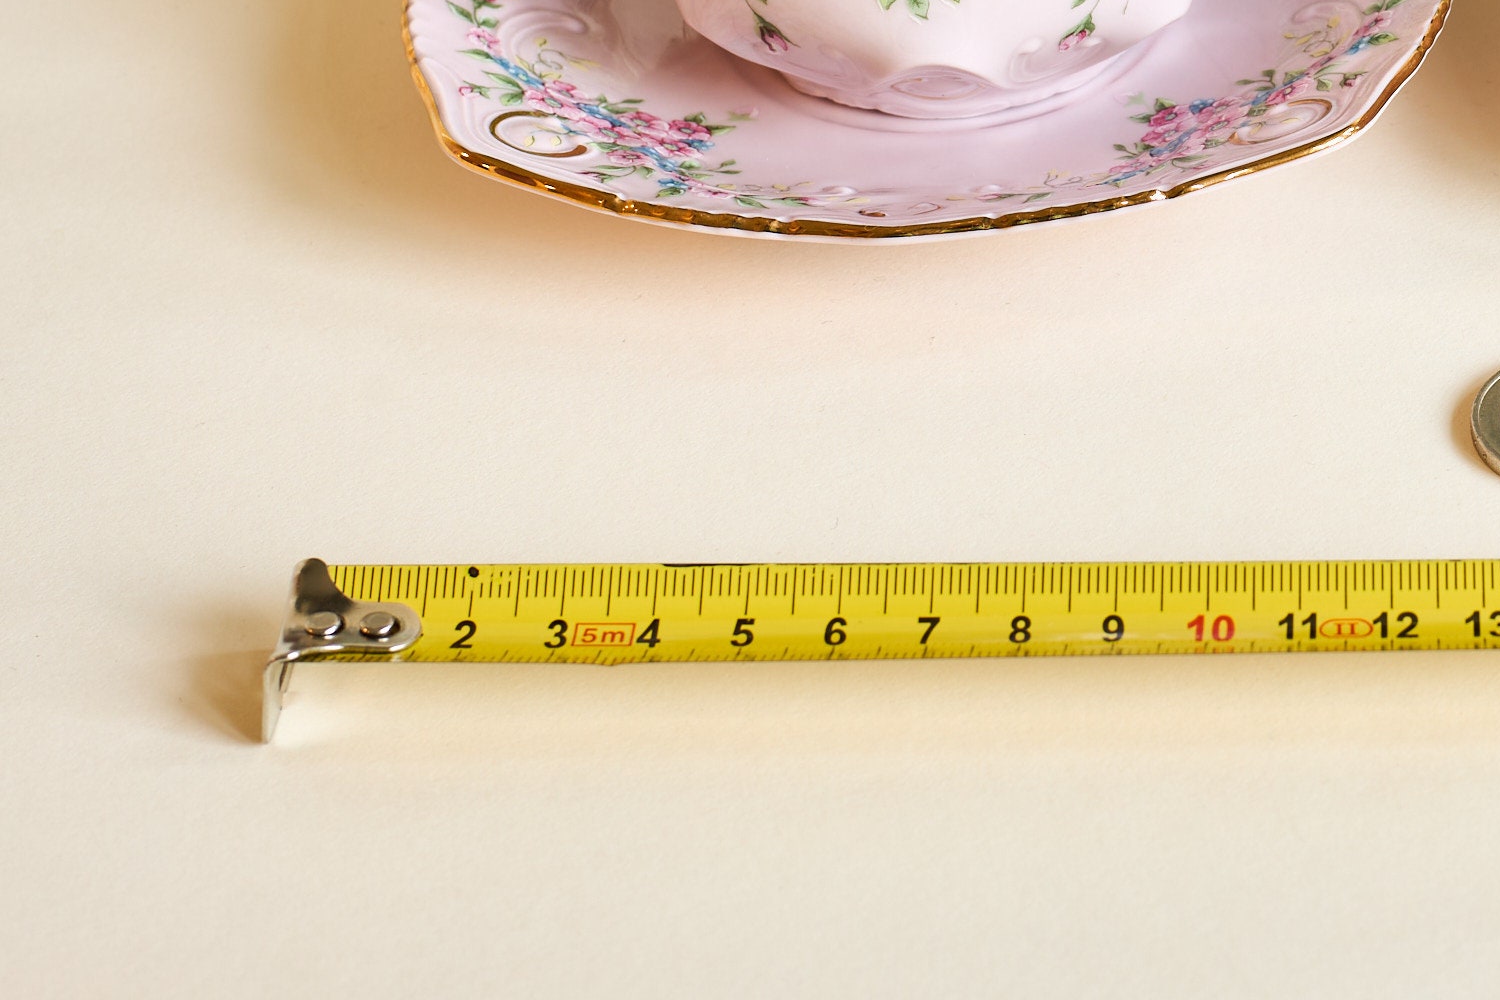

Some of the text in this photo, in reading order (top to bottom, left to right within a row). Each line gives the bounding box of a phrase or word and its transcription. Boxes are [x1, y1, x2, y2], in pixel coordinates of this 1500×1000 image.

[449, 619, 477, 649] 2
[543, 619, 568, 649] 3
[581, 627, 626, 644] 5m
[635, 618, 661, 649] 4
[730, 618, 755, 647] 5
[823, 617, 847, 646] 6
[917, 616, 941, 645] 7
[1008, 615, 1031, 644] 8
[1102, 614, 1125, 643] 9
[1187, 615, 1235, 642] 10
[1278, 612, 1317, 640] 11
[1372, 611, 1419, 639] 12
